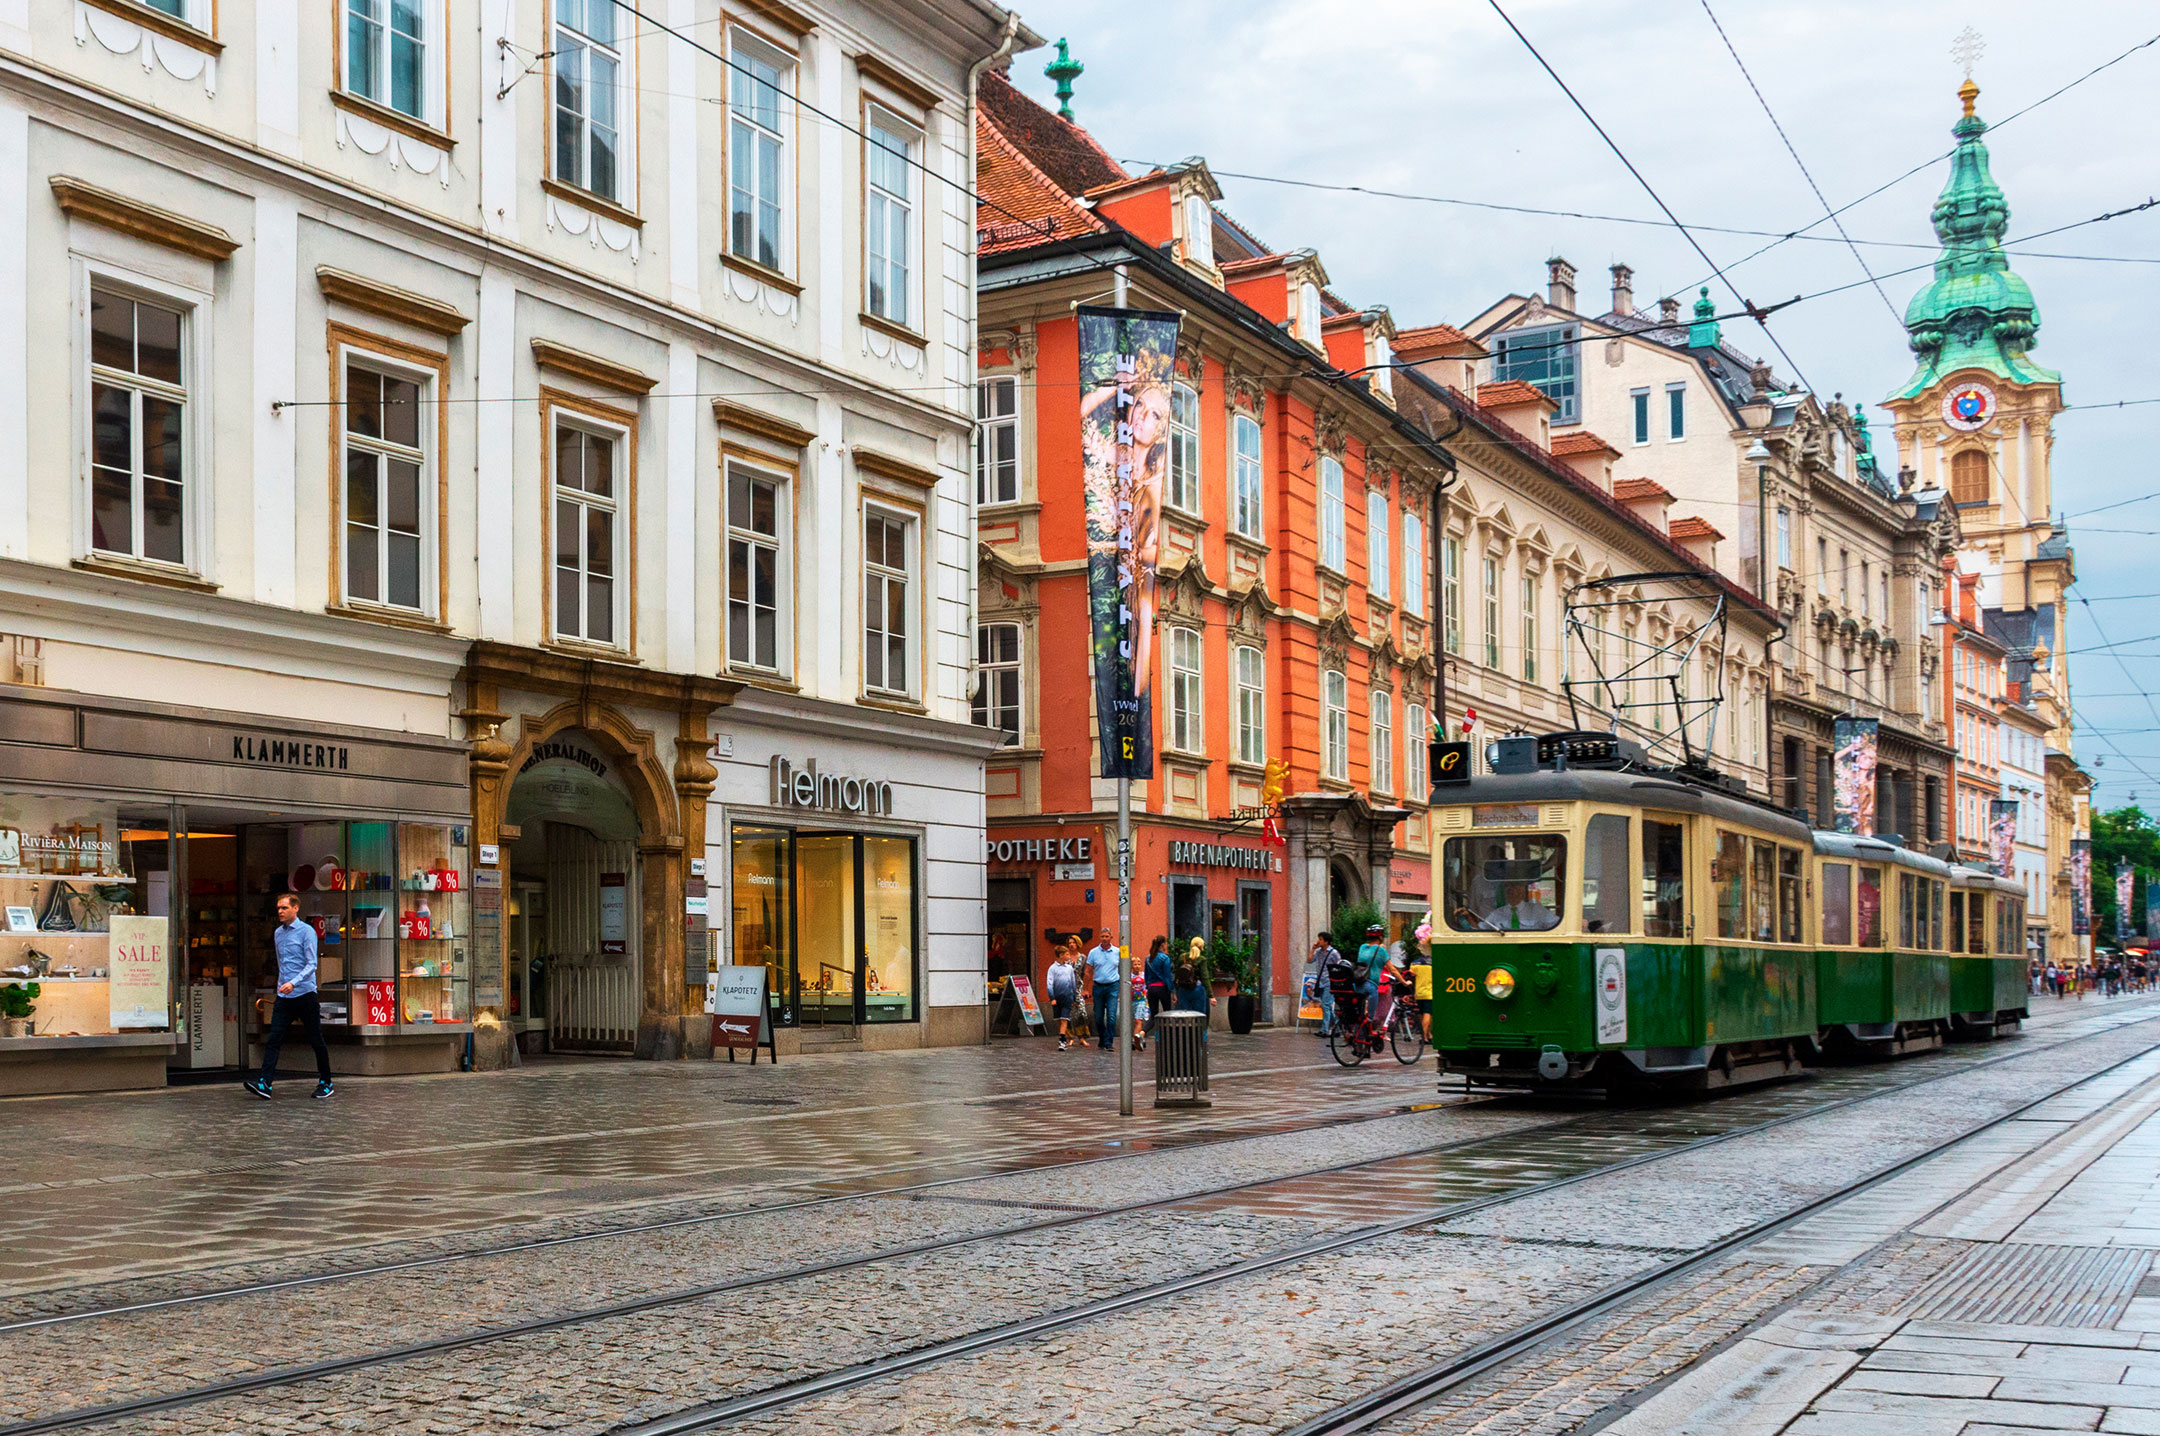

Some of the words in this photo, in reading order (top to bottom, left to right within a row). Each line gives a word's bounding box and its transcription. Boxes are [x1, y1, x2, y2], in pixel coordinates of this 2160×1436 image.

[233, 736, 348, 769] KLAMMERTH
[118, 944, 162, 962] SALE
[722, 986, 758, 995] KLAPOTETZ
[1445, 977, 1476, 993] 206
[194, 989, 203, 1051] KLAMMERTH
